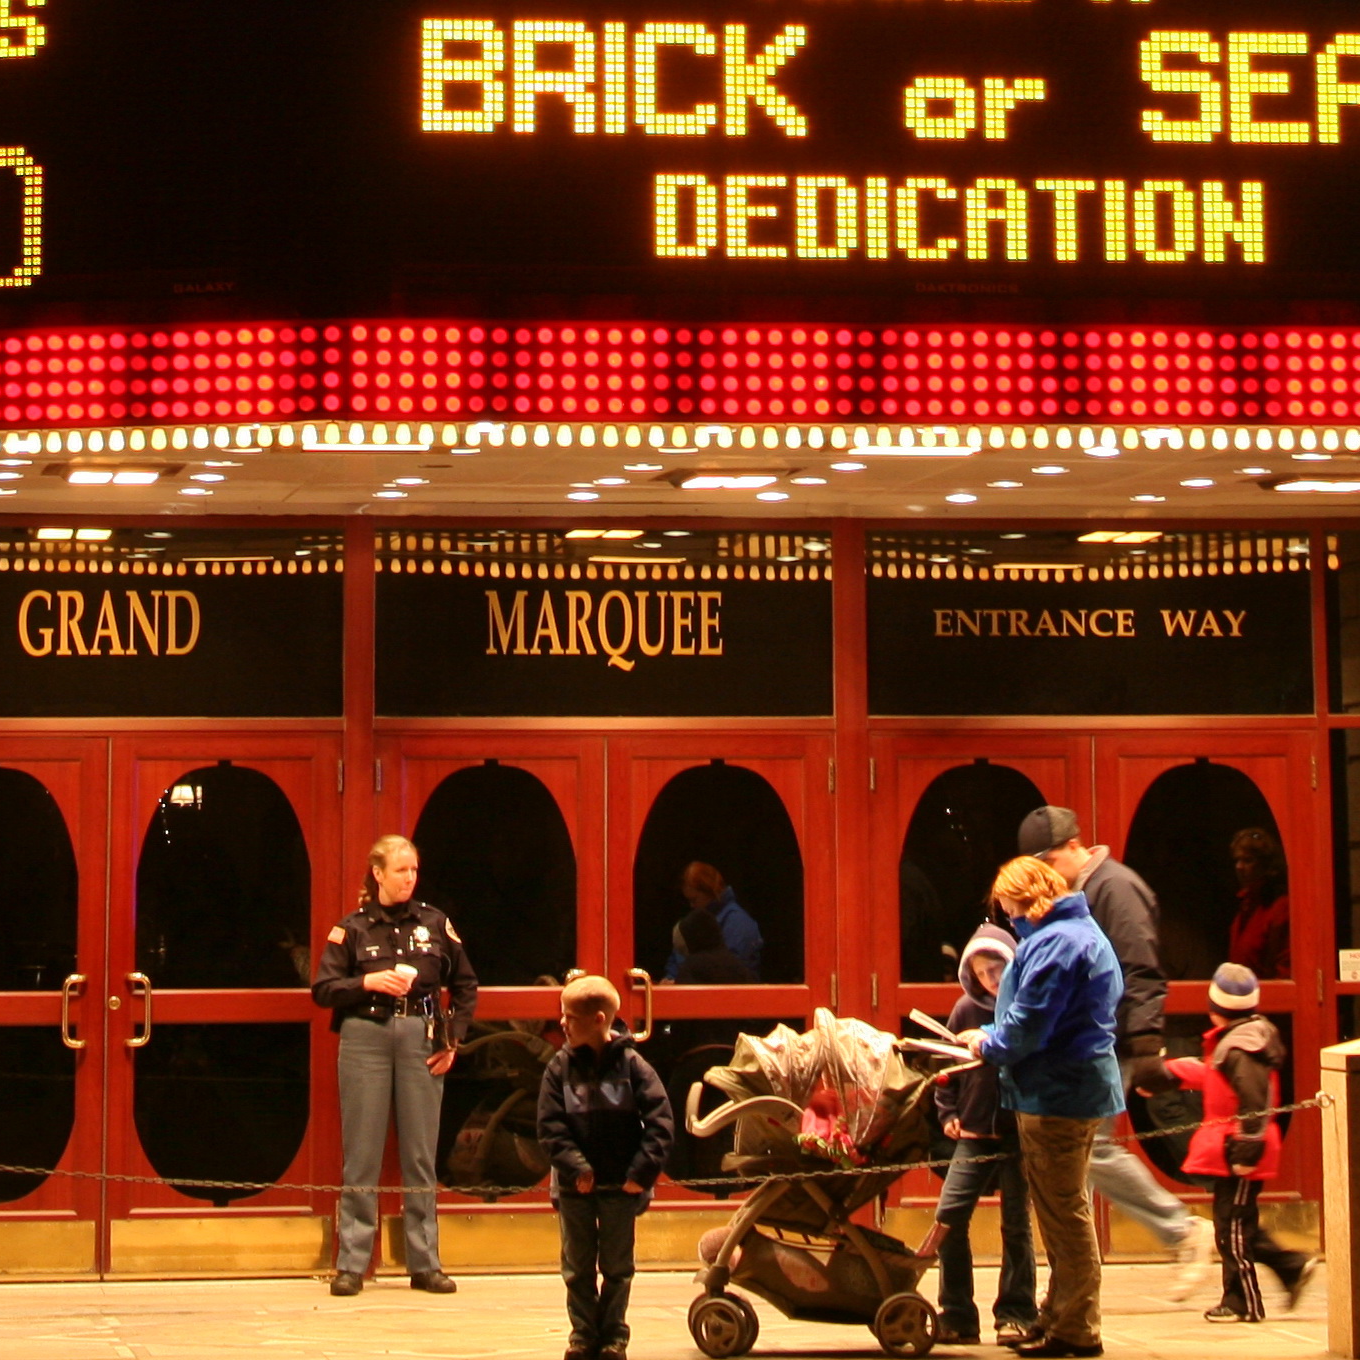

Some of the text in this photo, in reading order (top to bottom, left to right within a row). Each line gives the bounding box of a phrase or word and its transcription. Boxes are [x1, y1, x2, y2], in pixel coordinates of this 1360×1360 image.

[418, 16, 810, 139] BRICK
[902, 75, 1048, 141] or
[651, 171, 1267, 264] DEDICATION
[17, 589, 201, 658] GRAND
[484, 589, 724, 673] MARQUEE
[933, 608, 1247, 638] ENTRANCE WAY
